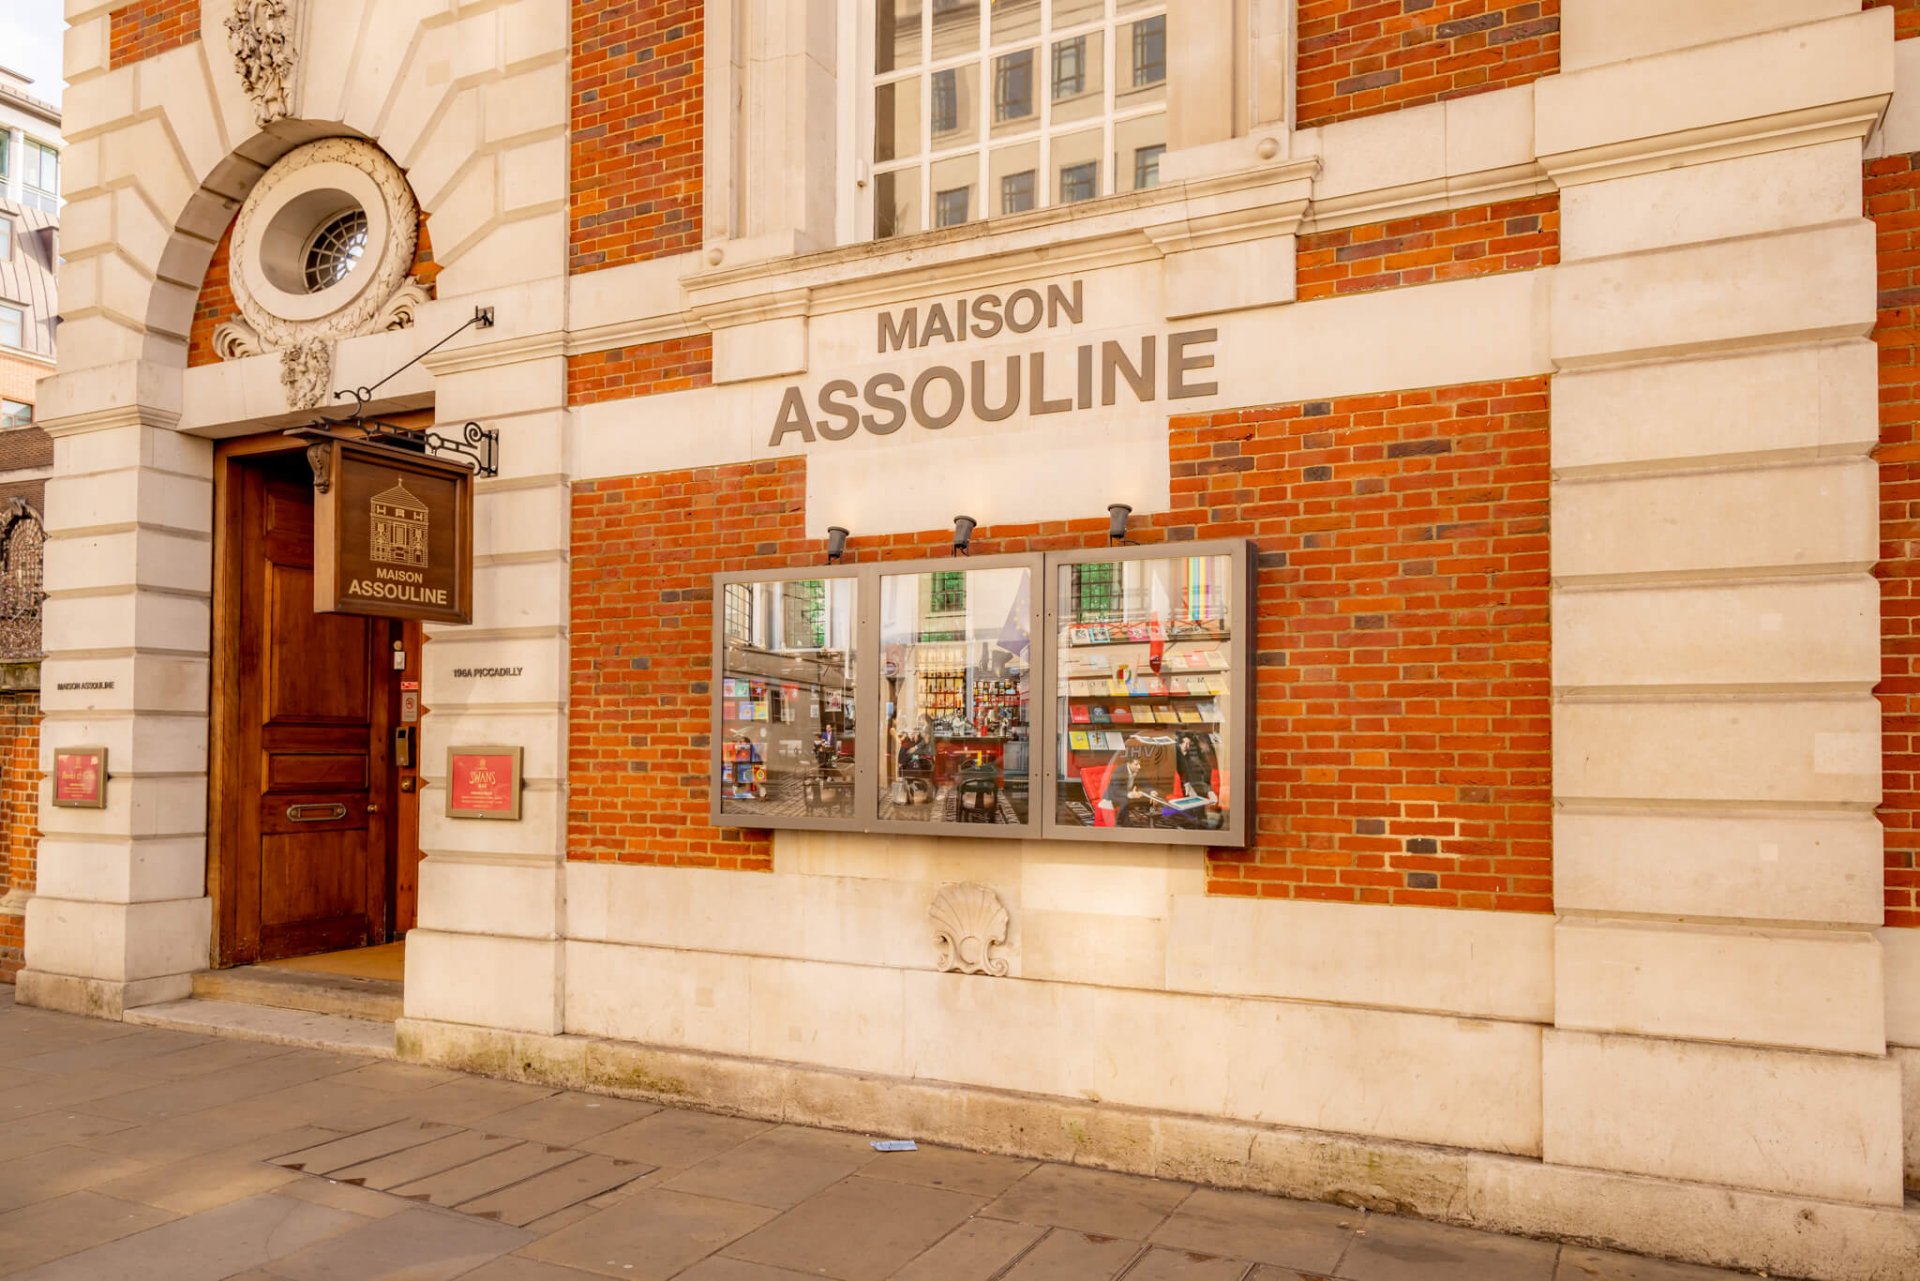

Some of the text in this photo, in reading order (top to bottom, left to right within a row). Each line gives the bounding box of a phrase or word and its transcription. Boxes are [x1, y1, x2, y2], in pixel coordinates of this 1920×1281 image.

[877, 279, 1084, 354] MAISON
[768, 328, 1219, 447] ASSOULINE
[376, 567, 423, 584] MAISON
[348, 579, 448, 605] ASSOULINE
[453, 666, 523, 678] 196A PICCADILLY
[468, 771, 496, 785] SWANS
